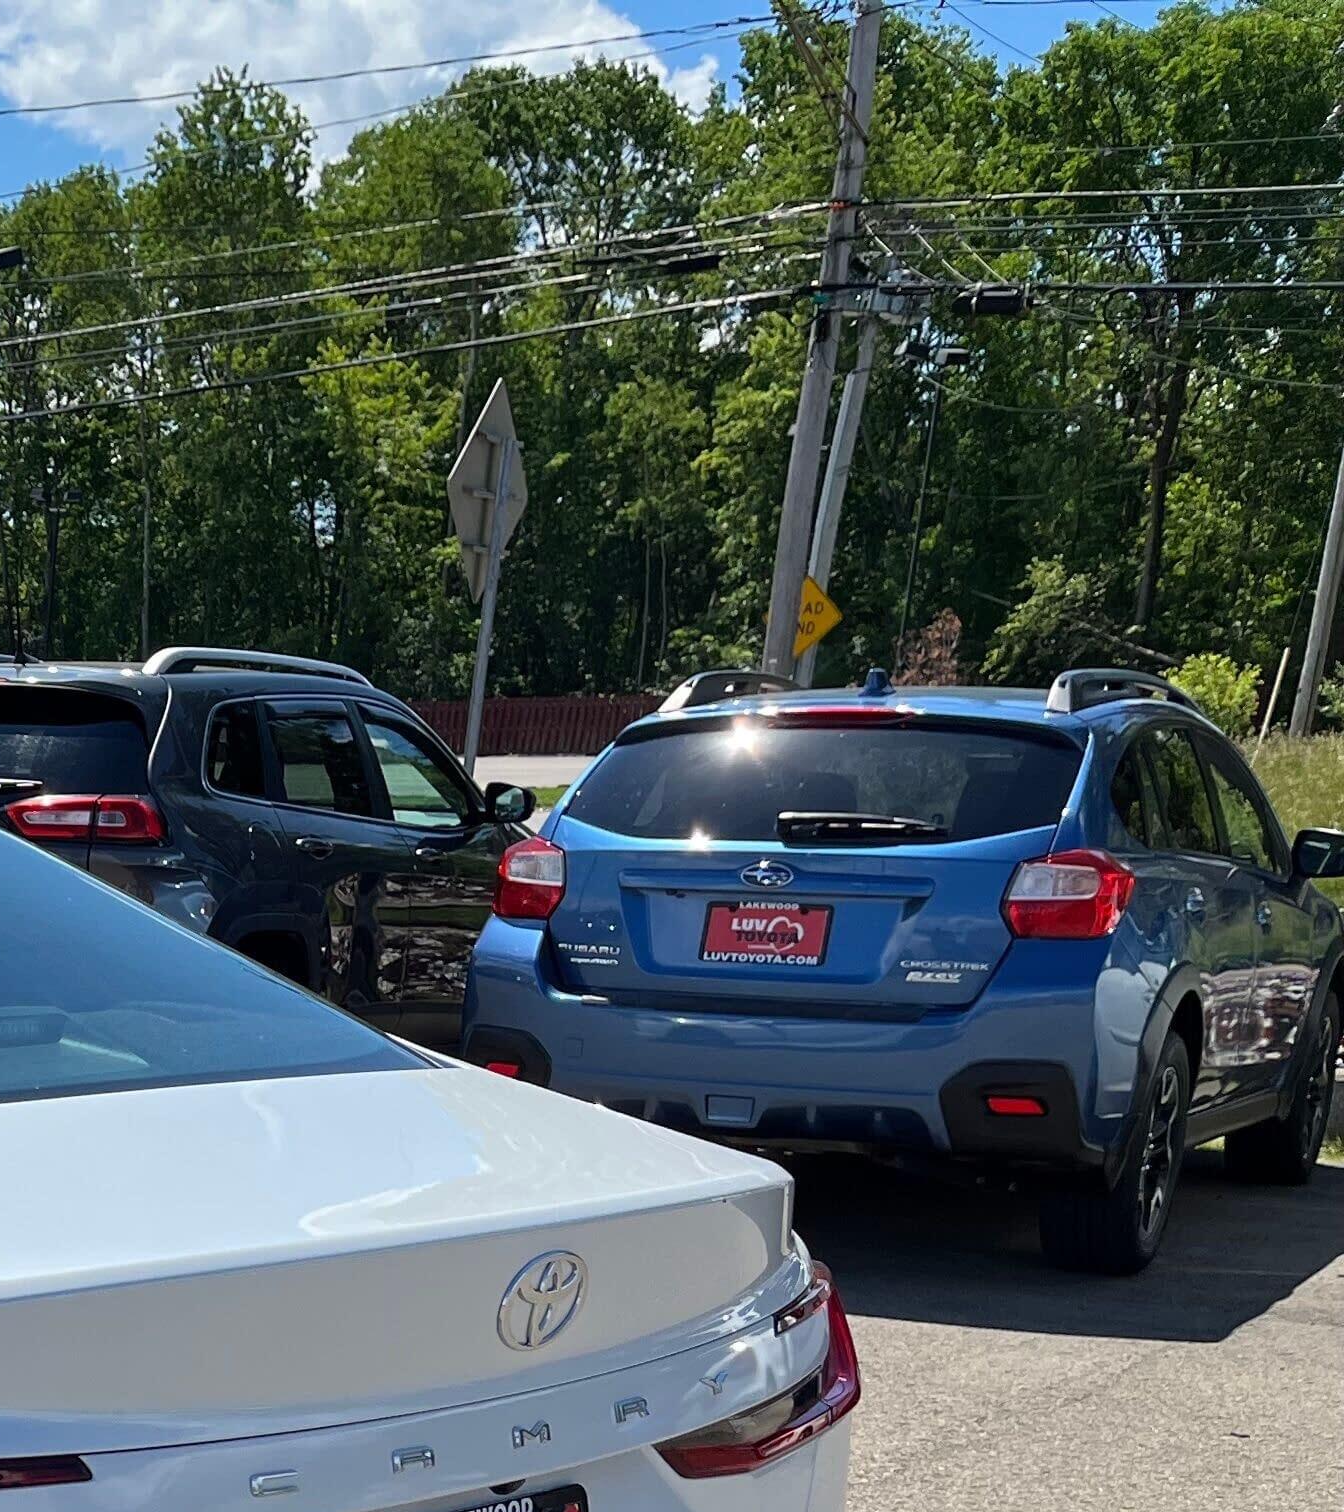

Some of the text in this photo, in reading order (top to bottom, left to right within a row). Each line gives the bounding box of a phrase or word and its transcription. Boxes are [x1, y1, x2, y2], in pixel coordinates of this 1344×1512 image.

[802, 601, 824, 615] AD
[796, 620, 816, 634] ND
[739, 901, 800, 911] LAKEWOOD
[730, 917, 768, 931] LUV
[735, 930, 800, 944] TOYOTA
[558, 943, 621, 955] SUBARU
[703, 951, 819, 966] LUVTOYOTA.COM
[900, 959, 990, 971] CROSSTREK
[249, 1370, 729, 1498] CAMRY
